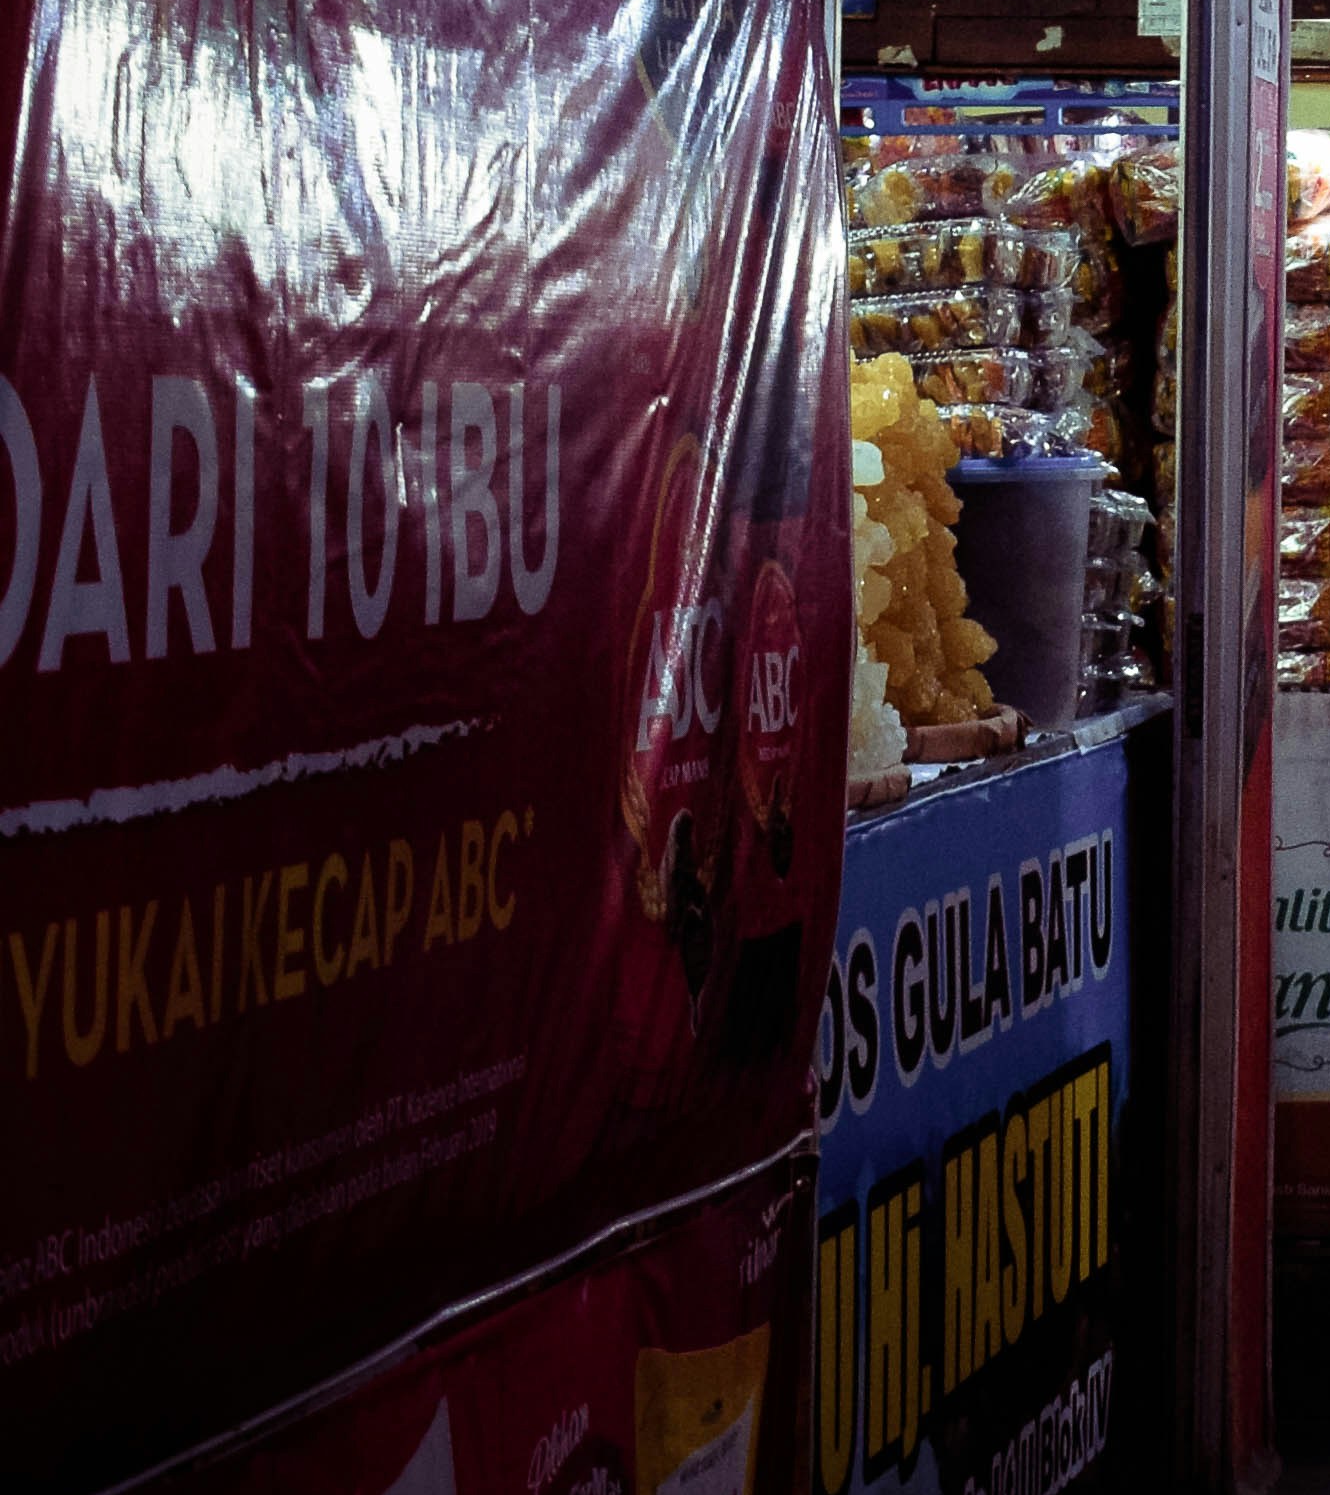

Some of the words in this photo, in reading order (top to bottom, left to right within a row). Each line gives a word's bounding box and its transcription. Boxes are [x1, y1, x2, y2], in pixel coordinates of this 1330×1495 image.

[422, 382, 562, 626] IBU
[745, 640, 801, 738] ABC
[8, 878, 225, 1081] YUKAI
[239, 831, 412, 1015] KECAP
[893, 874, 1012, 1074] GULA
[1019, 830, 1115, 990] BATU
[942, 1058, 1111, 1398] HASTUTI
